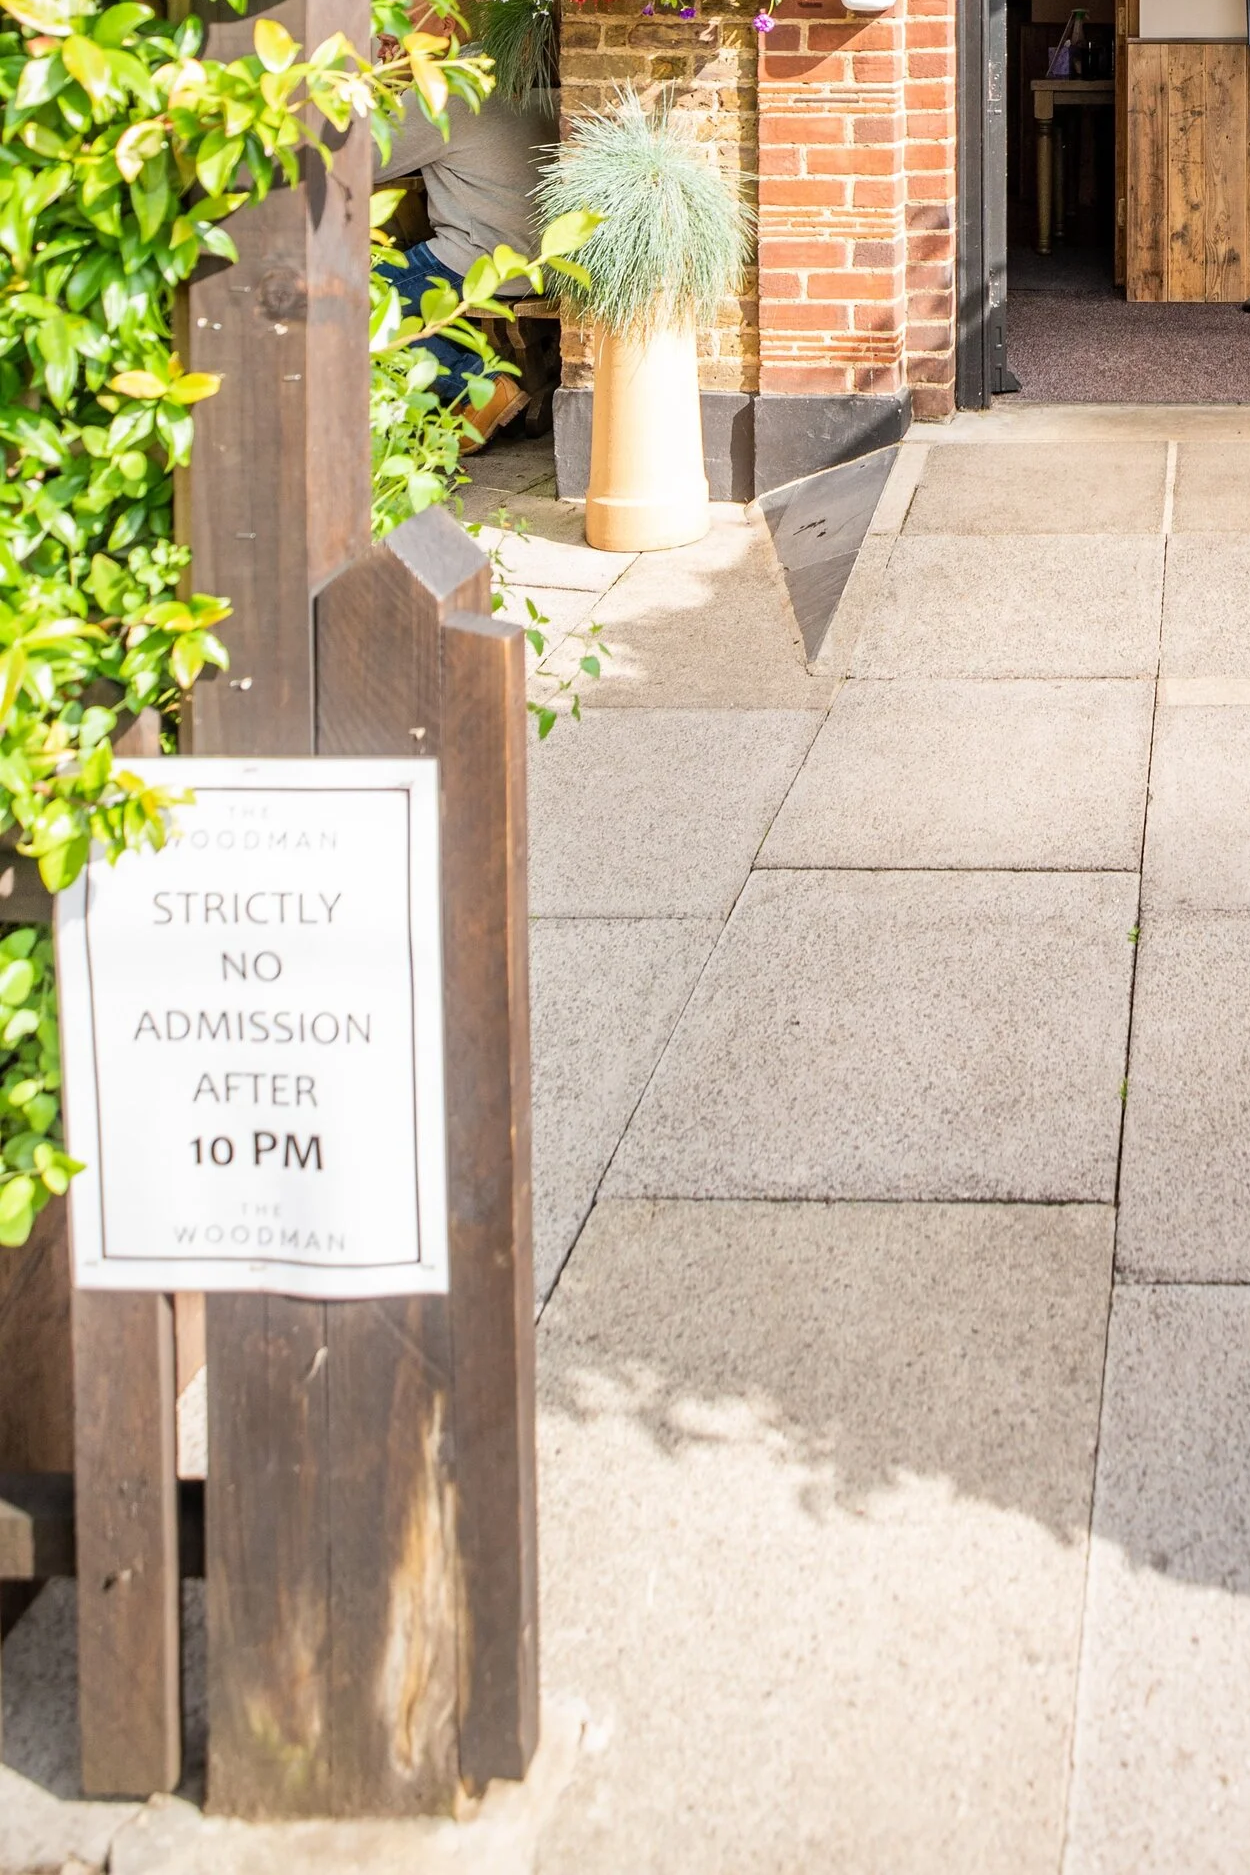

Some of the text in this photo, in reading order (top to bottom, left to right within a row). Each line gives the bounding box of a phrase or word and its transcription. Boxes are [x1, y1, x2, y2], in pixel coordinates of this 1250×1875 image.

[227, 805, 270, 821] THE
[166, 829, 338, 851] OODMAN
[153, 892, 342, 925] STRICTLY
[221, 951, 283, 982] NO
[133, 1010, 372, 1044] ADMISSION
[192, 1073, 319, 1107] AFTER
[190, 1131, 324, 1171] 10 PM
[241, 1202, 282, 1219] THE
[174, 1224, 347, 1252] WOODMAN
